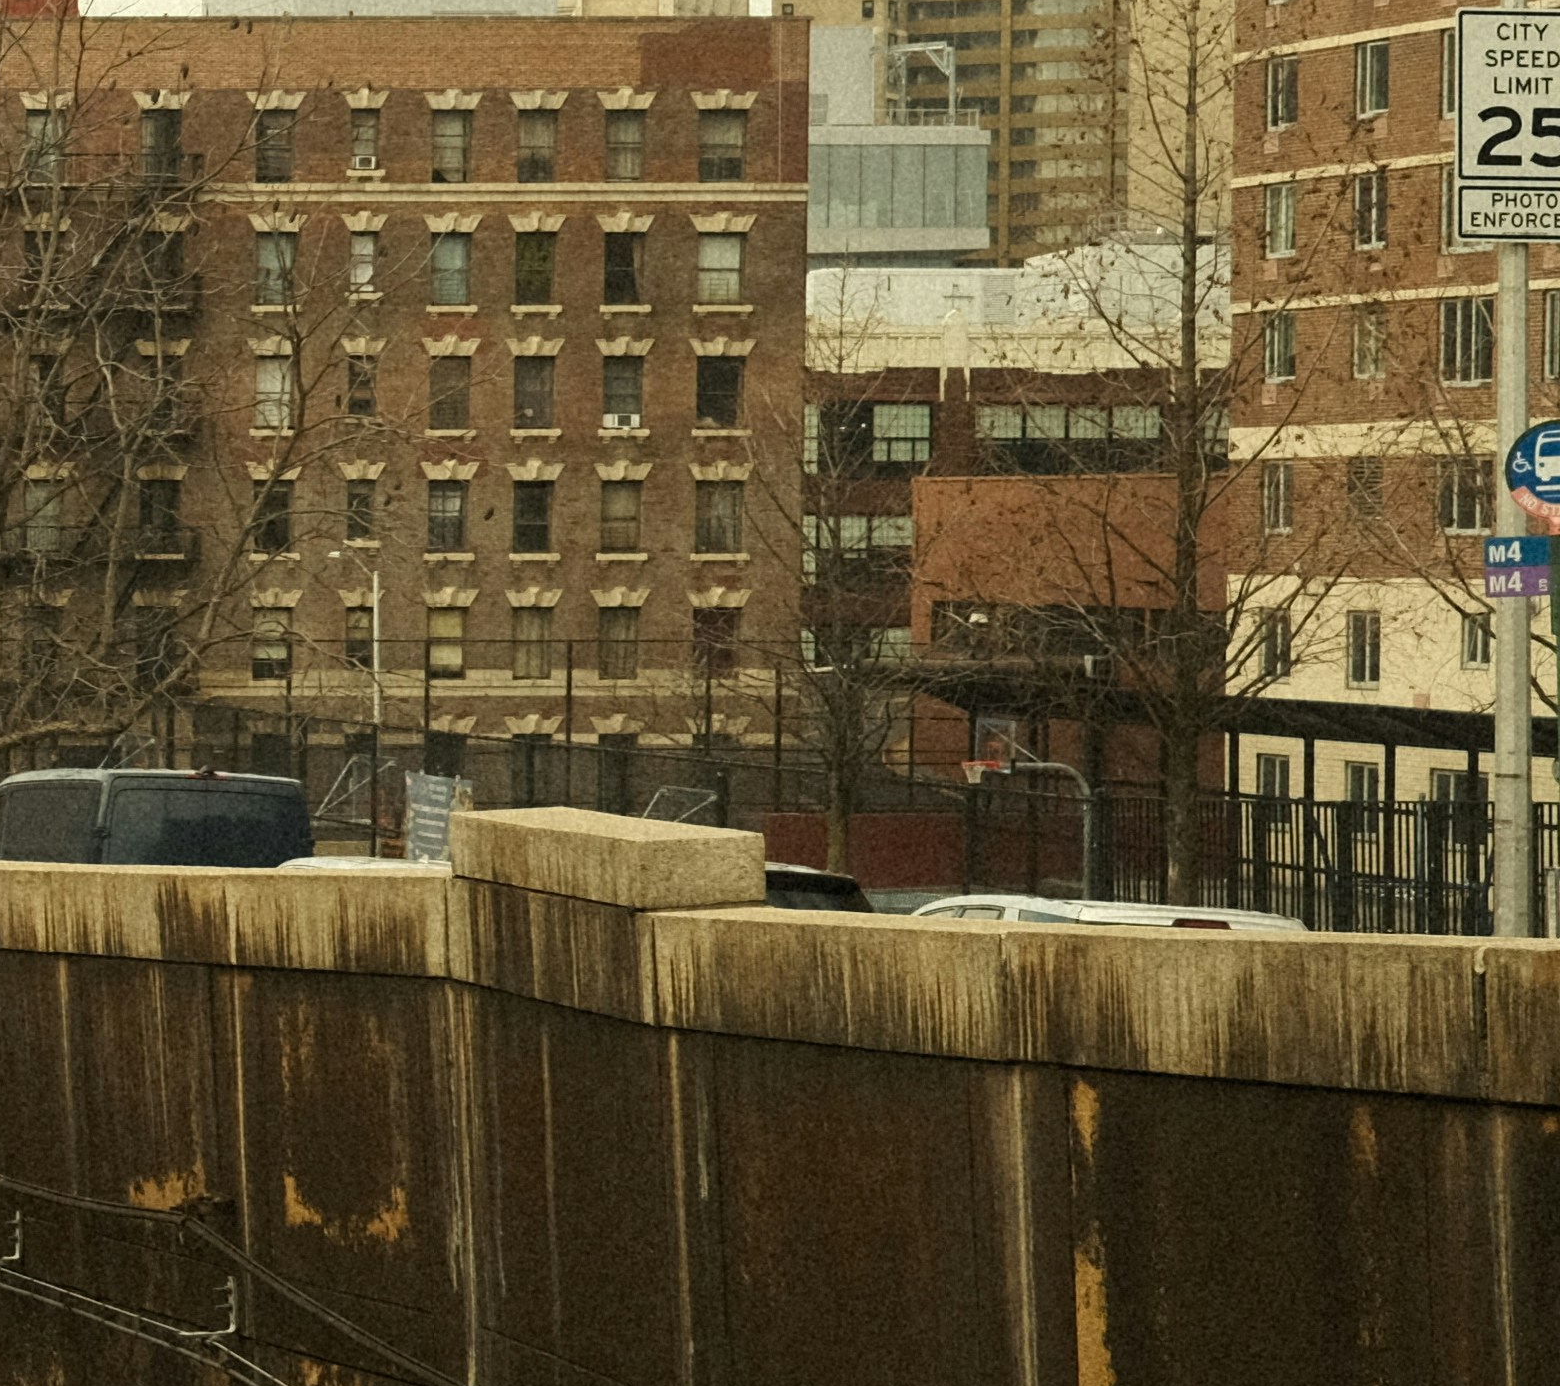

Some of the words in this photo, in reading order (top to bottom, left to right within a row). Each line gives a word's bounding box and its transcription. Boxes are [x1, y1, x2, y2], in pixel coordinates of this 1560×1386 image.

[1497, 23, 1549, 41] CITY
[1485, 50, 1560, 68] SPEED
[1493, 77, 1553, 95] LIMIT
[1477, 106, 1560, 167] 25
[1492, 193, 1558, 208] PHOTO
[1488, 541, 1522, 563] M4
[1489, 571, 1522, 593] M4
